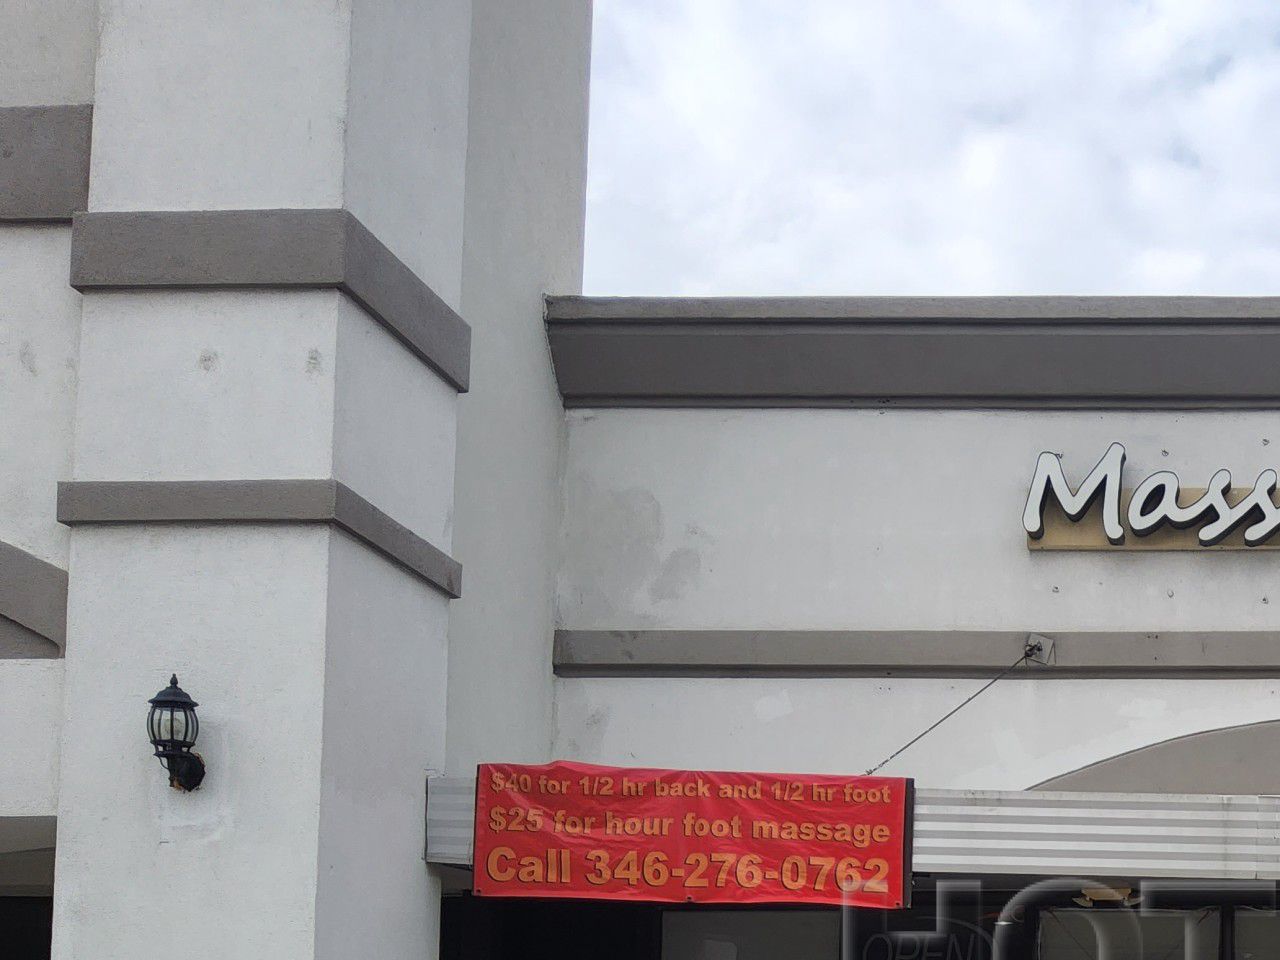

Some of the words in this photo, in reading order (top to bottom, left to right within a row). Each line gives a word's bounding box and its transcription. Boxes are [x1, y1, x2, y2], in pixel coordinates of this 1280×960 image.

[491, 771, 531, 793] $40
[539, 776, 569, 796] for
[579, 777, 613, 797] 1/2
[622, 778, 645, 797] hr
[654, 777, 710, 799] back
[719, 779, 761, 800] and
[771, 781, 804, 802] 1/2
[812, 782, 838, 802] hr
[844, 782, 891, 804] foot
[488, 805, 543, 834] $25
[553, 809, 596, 835] for
[606, 810, 674, 838] hour
[683, 812, 742, 839] foot
[752, 818, 891, 847] massage
[487, 846, 571, 885] Call
[585, 850, 890, 893] 346-276-0762
